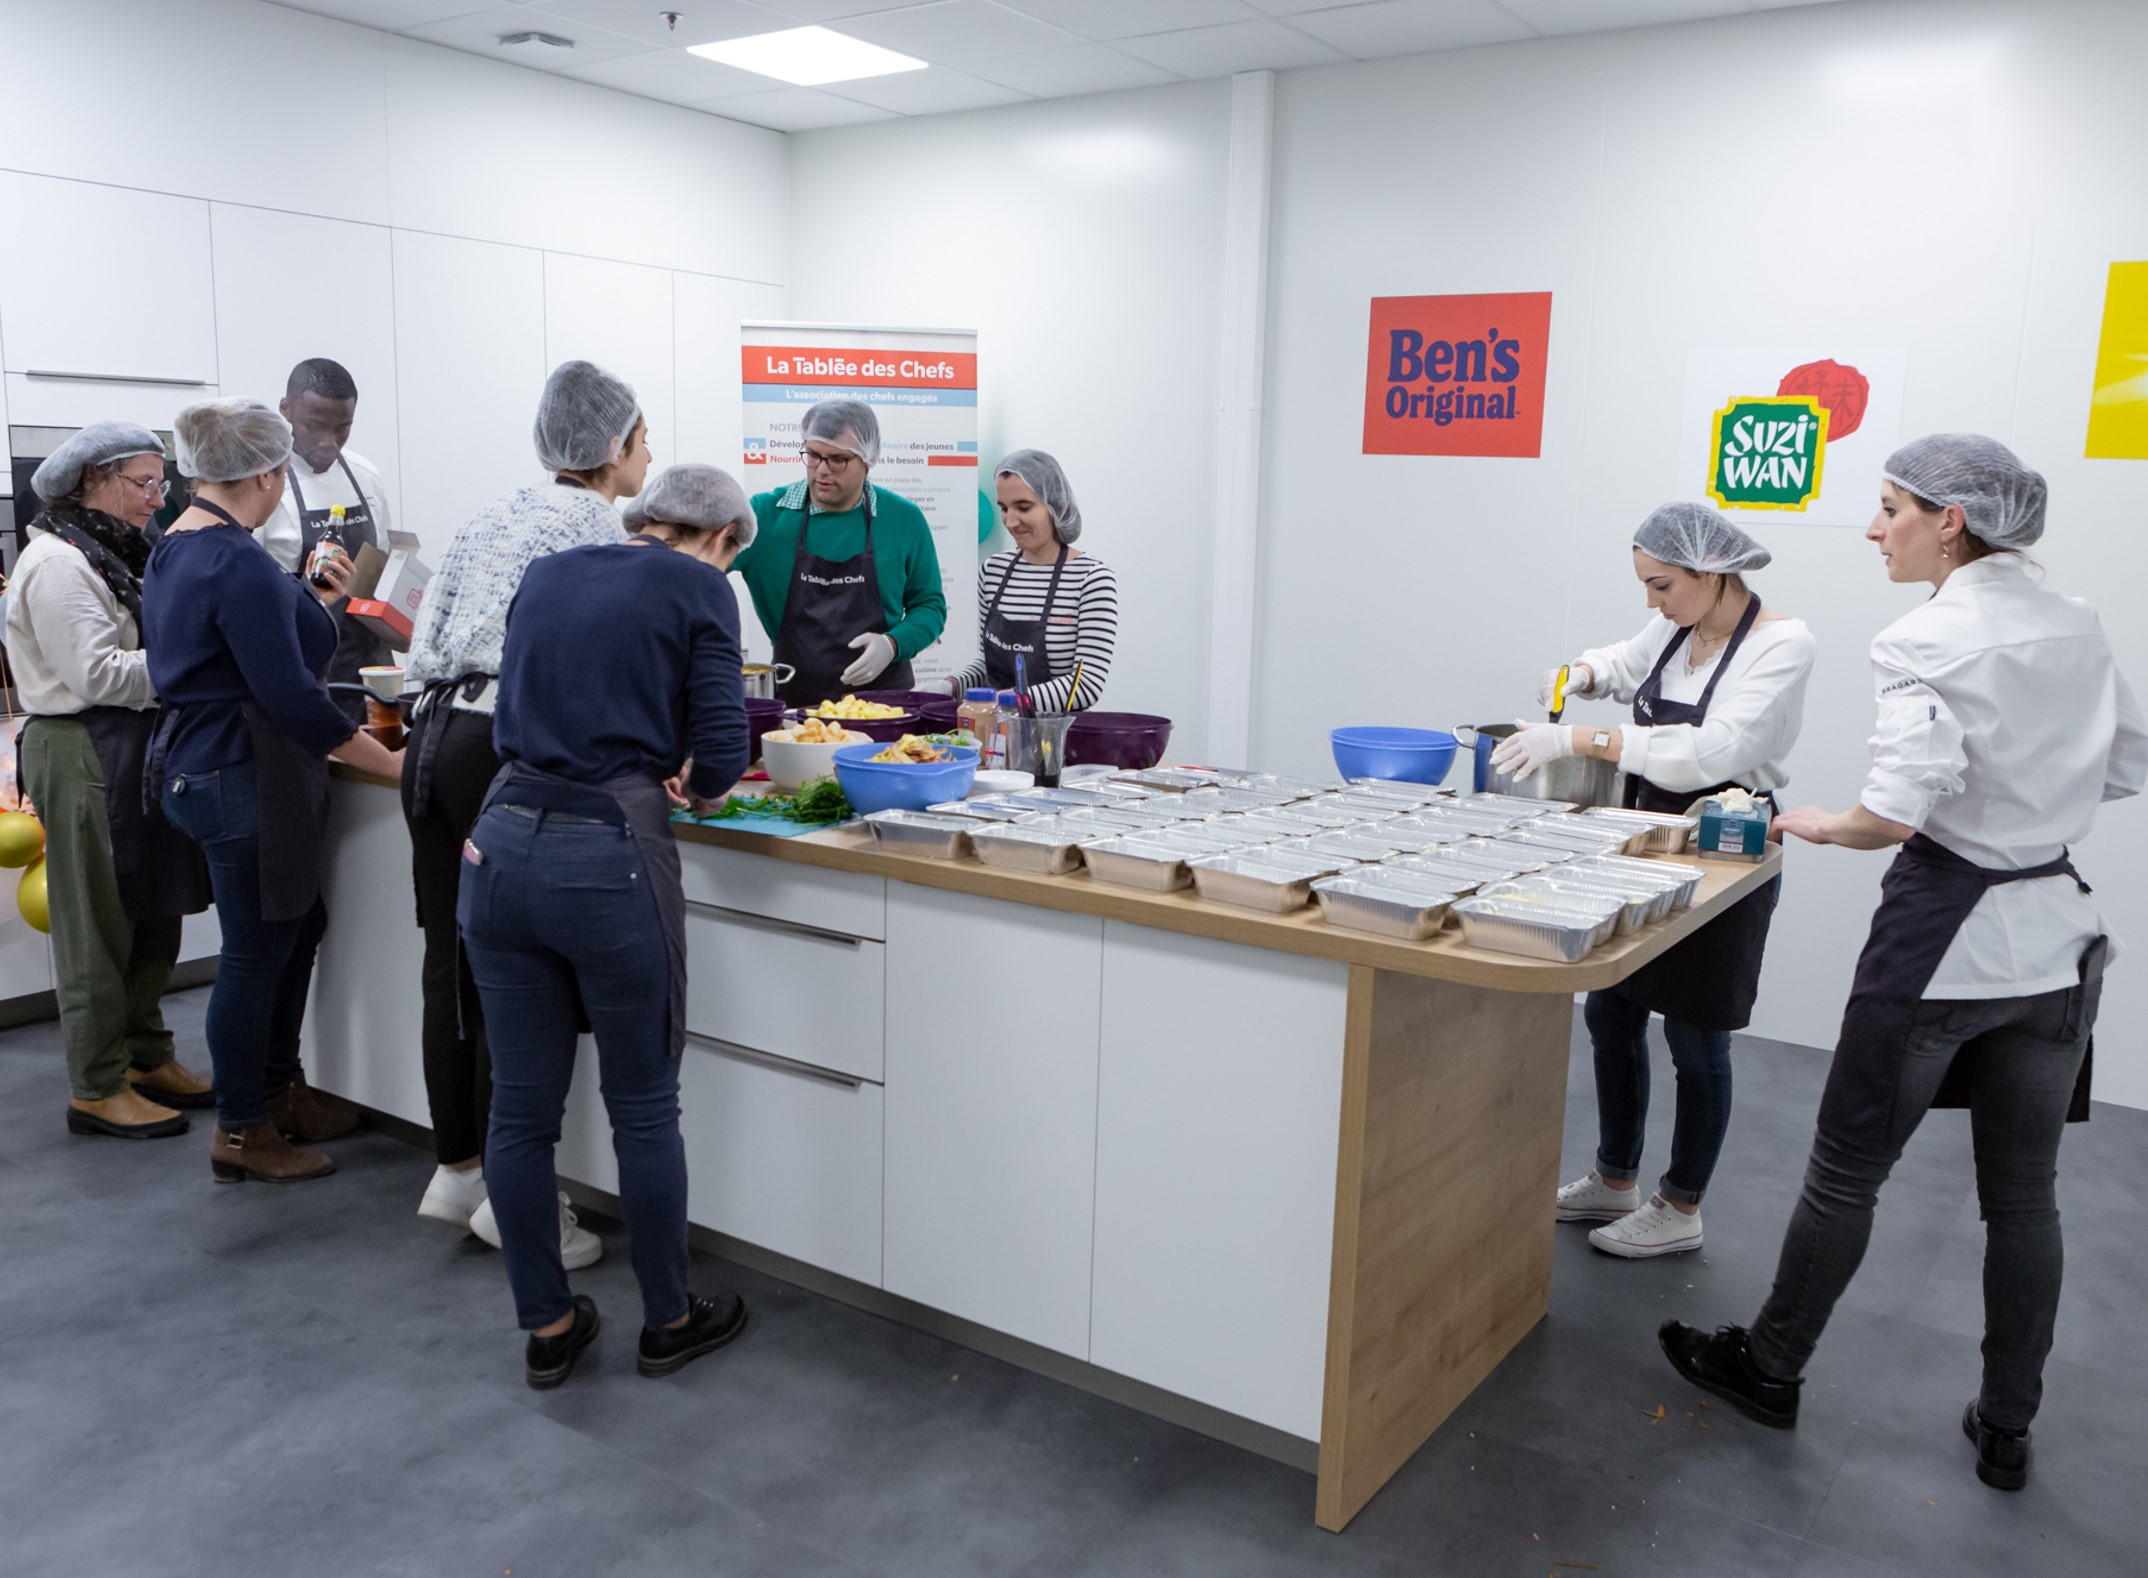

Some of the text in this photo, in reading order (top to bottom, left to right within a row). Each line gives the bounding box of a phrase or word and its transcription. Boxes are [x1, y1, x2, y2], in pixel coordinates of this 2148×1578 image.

[1387, 328, 1520, 383] Ben's
[767, 356, 789, 375] La
[861, 359, 896, 377] des
[900, 359, 954, 379] Chefs
[850, 391, 868, 400] des
[870, 391, 895, 401] chefs
[897, 393, 938, 404] engagés
[1386, 385, 1516, 426] Original
[769, 440, 804, 448] Dévelo
[909, 442, 925, 450] des
[925, 442, 954, 451] jeunes
[887, 456, 895, 464] le
[896, 456, 924, 464] besoin
[1723, 454, 1808, 489] WAN
[844, 574, 865, 584] Chefs
[1013, 643, 1034, 653] Chefs
